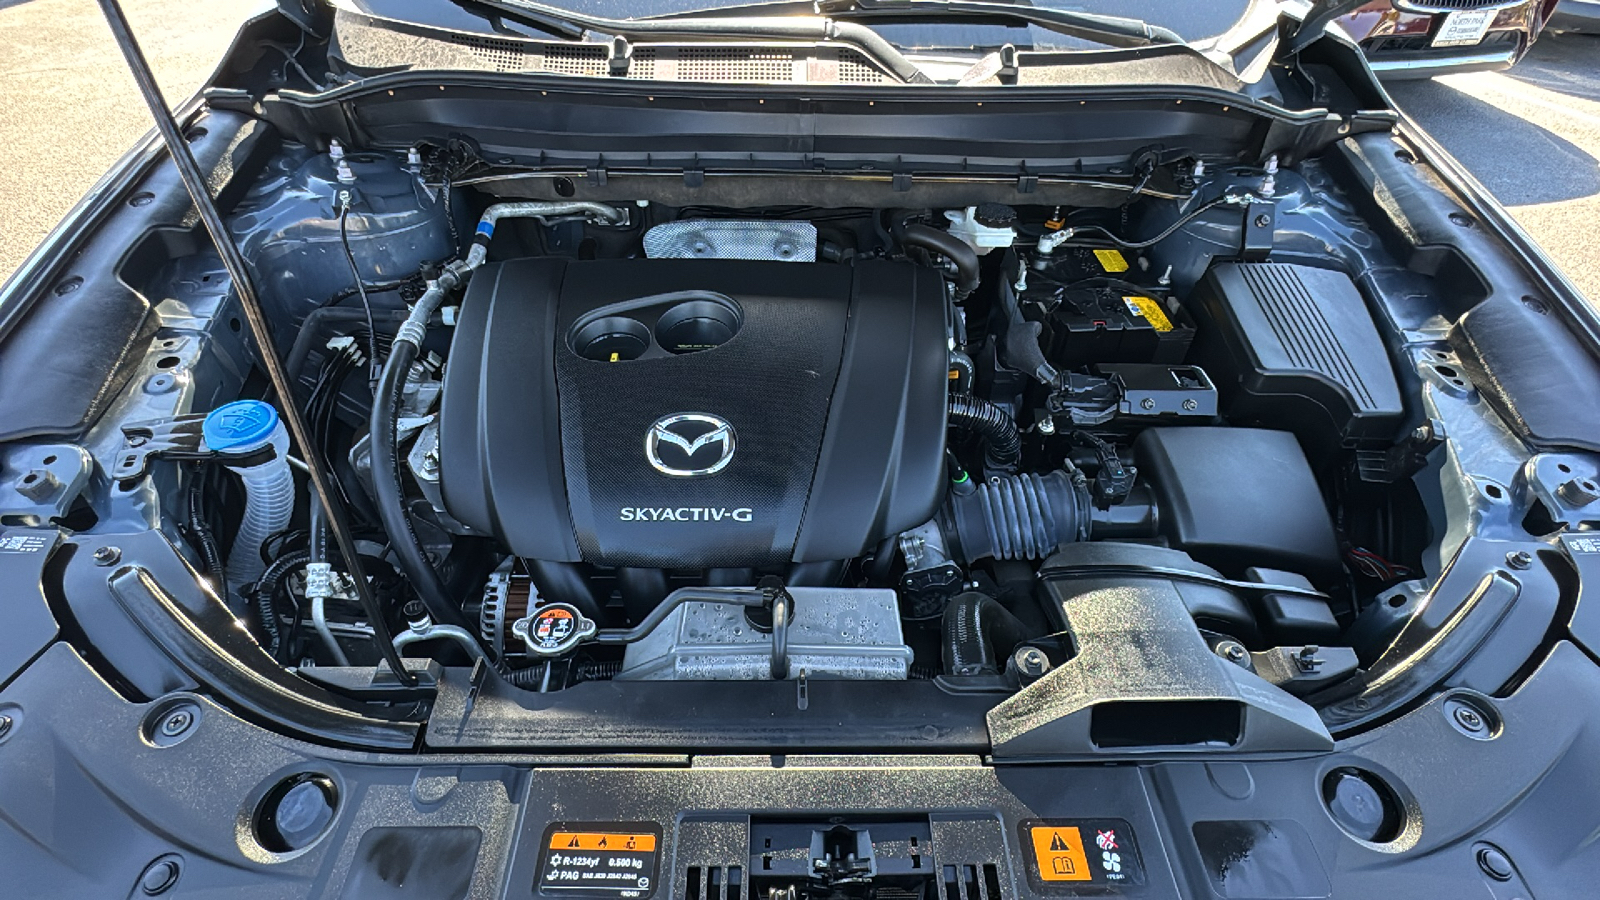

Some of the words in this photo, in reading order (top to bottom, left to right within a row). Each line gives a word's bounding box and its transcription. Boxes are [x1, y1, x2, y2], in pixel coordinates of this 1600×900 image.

[620, 507, 753, 522] SKYACTIV-G
[562, 856, 600, 868] R-1234yf
[608, 857, 631, 868] 0.500
[631, 857, 643, 869] kg
[560, 871, 579, 881] PAG
